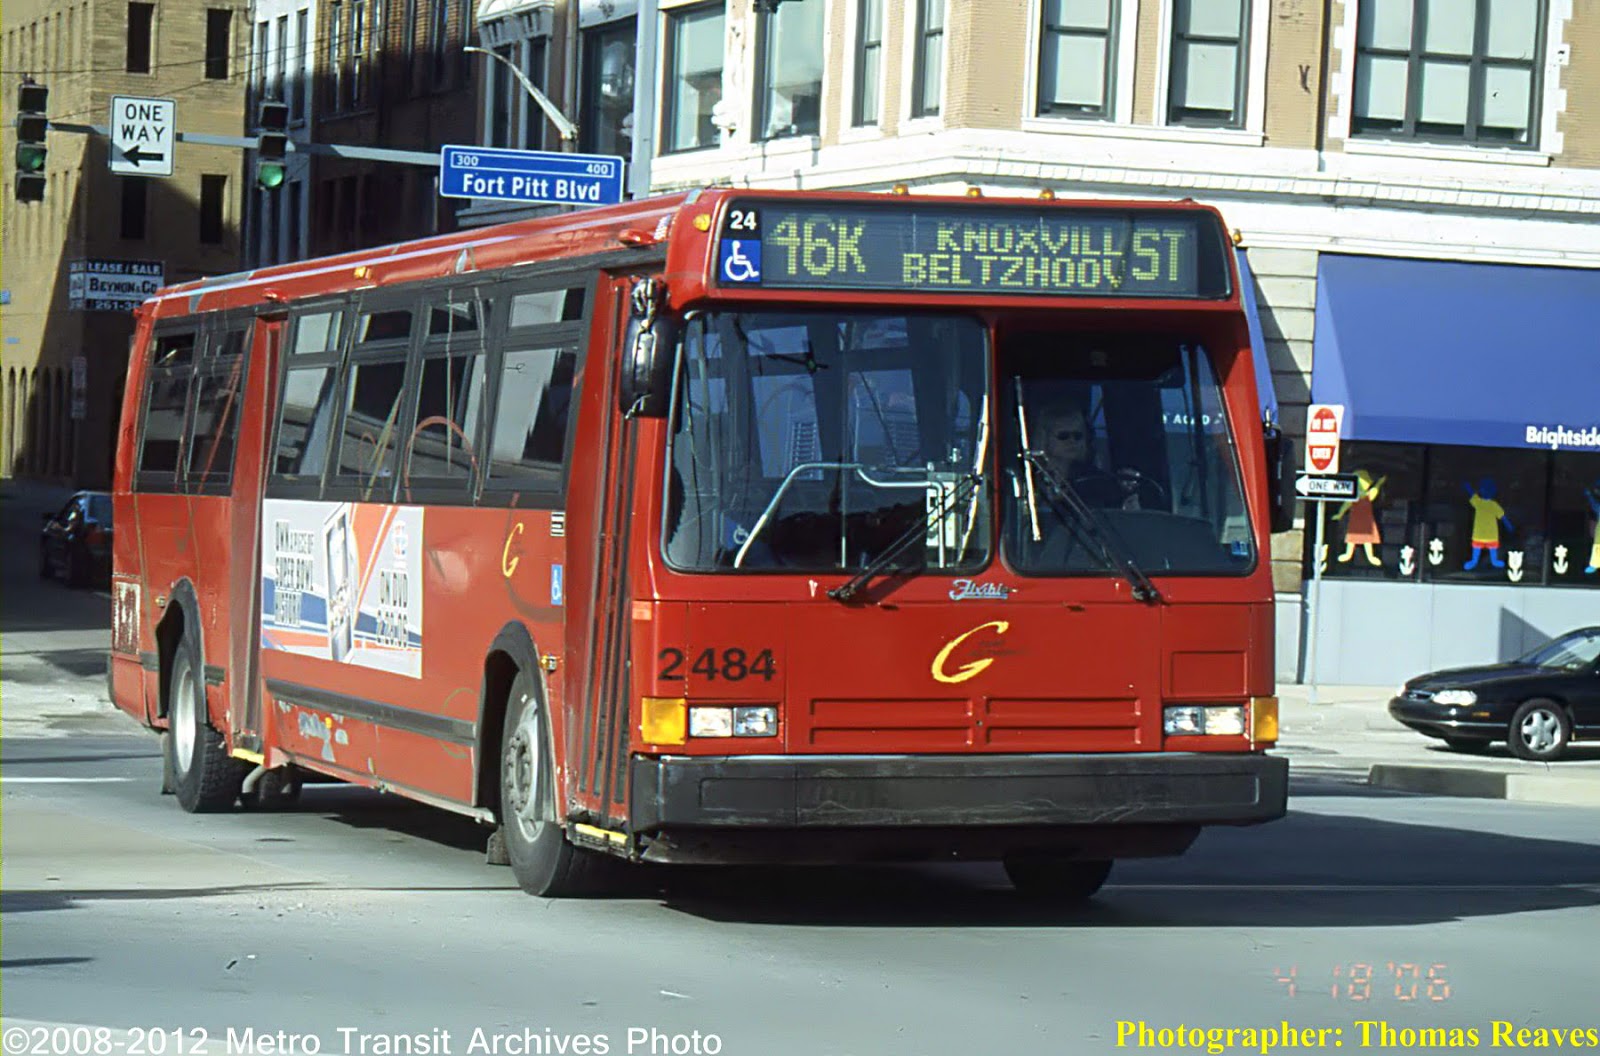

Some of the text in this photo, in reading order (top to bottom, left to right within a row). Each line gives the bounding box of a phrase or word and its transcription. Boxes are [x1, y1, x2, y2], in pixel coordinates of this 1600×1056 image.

[126, 104, 163, 121] ONE
[121, 125, 166, 142] WAY
[457, 155, 608, 175] 300 400
[463, 174, 600, 201] Fort Pitt Blvd
[730, 210, 757, 230] 24
[767, 213, 866, 276] 46K
[1132, 229, 1185, 281] ST
[87, 262, 123, 273] LEASE
[131, 264, 161, 275] SALE
[1309, 480, 1328, 491] ONE
[658, 647, 777, 682] 2484
